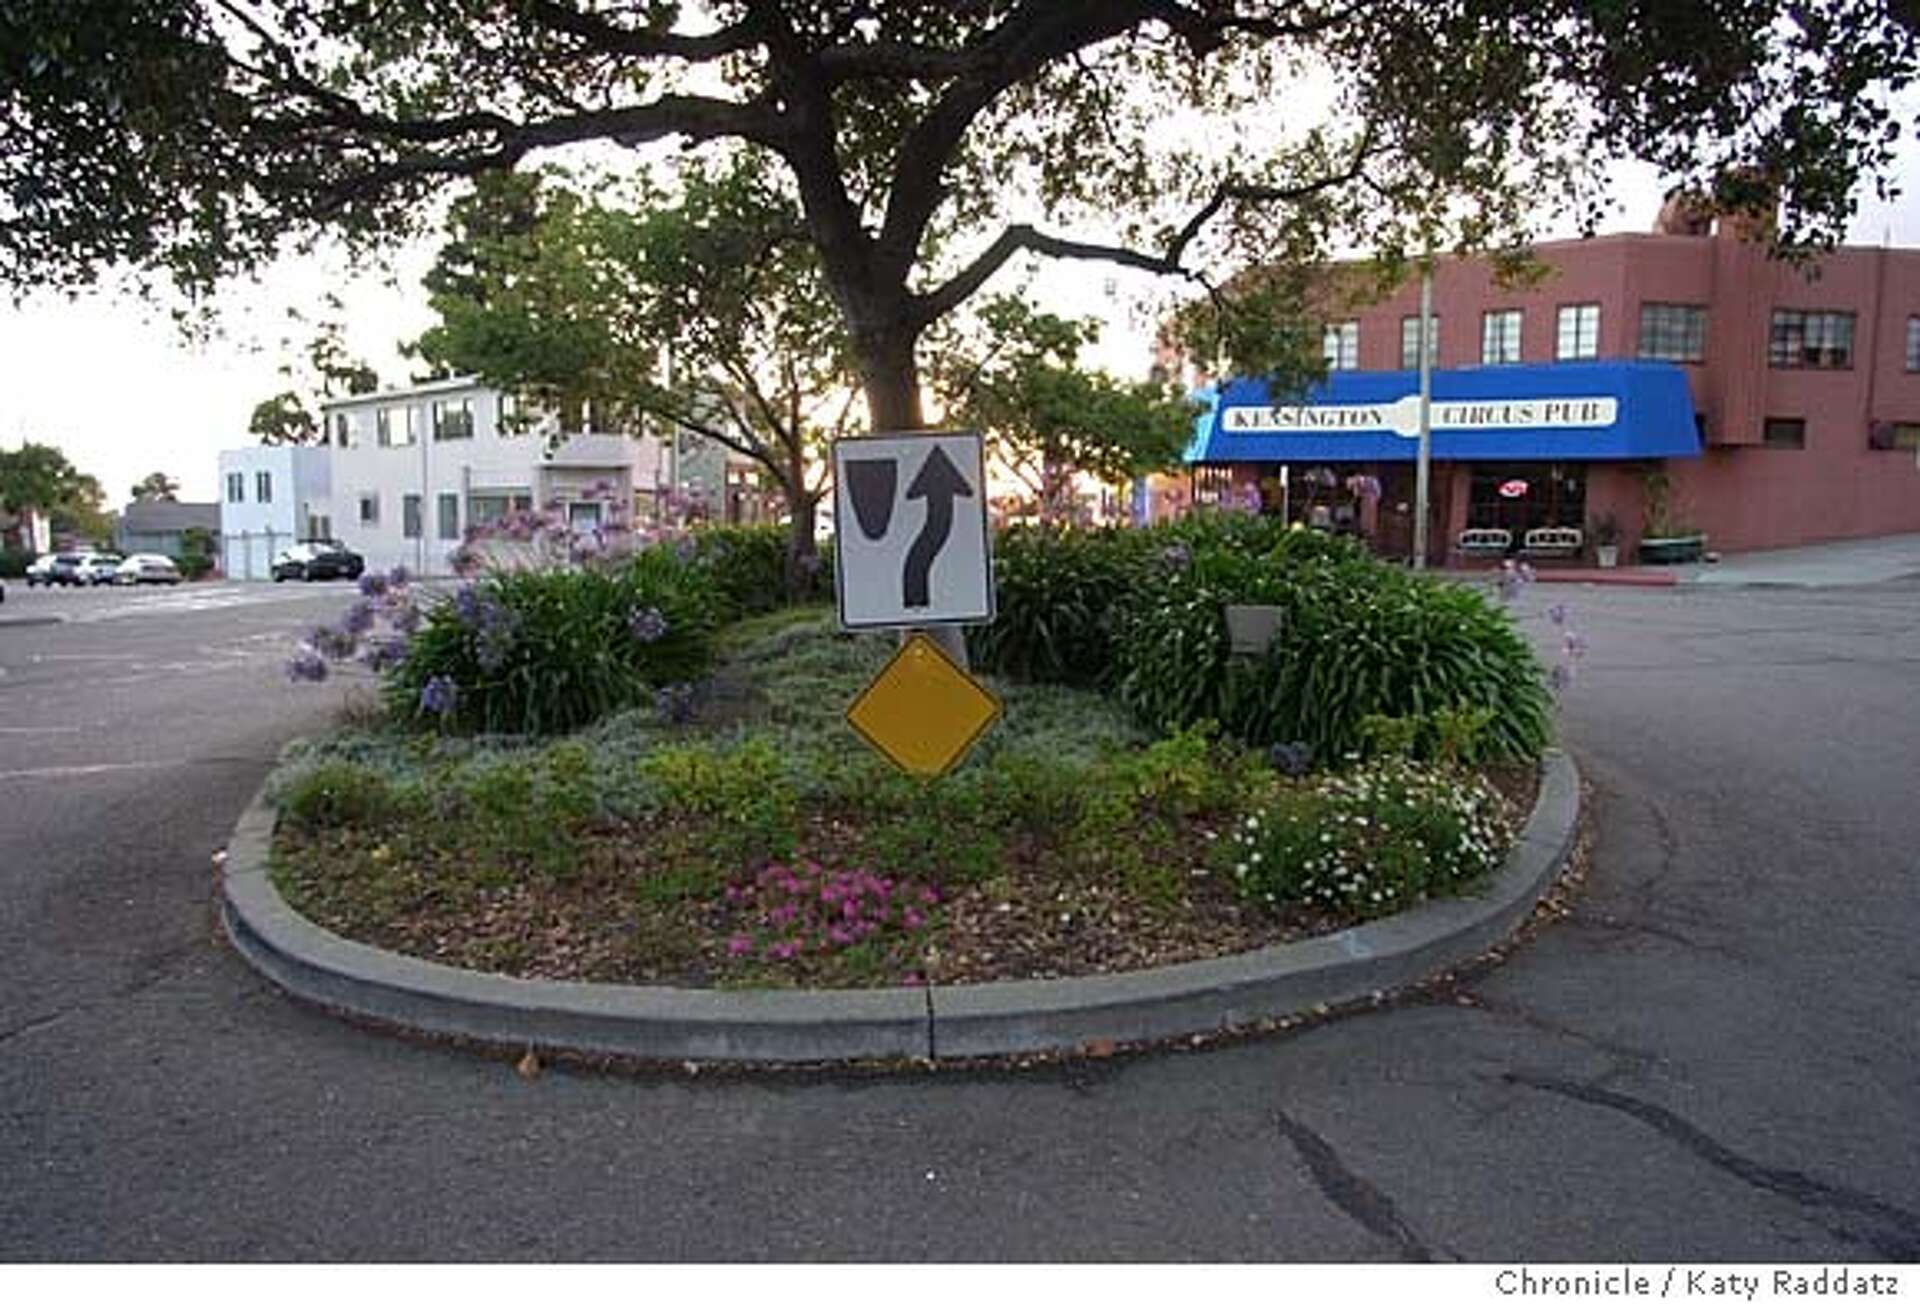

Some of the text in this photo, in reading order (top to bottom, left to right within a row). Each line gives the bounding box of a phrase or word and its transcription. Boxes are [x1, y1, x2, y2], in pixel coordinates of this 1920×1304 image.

[1232, 401, 1600, 428] KENSINGTON CIRCUS PUB
